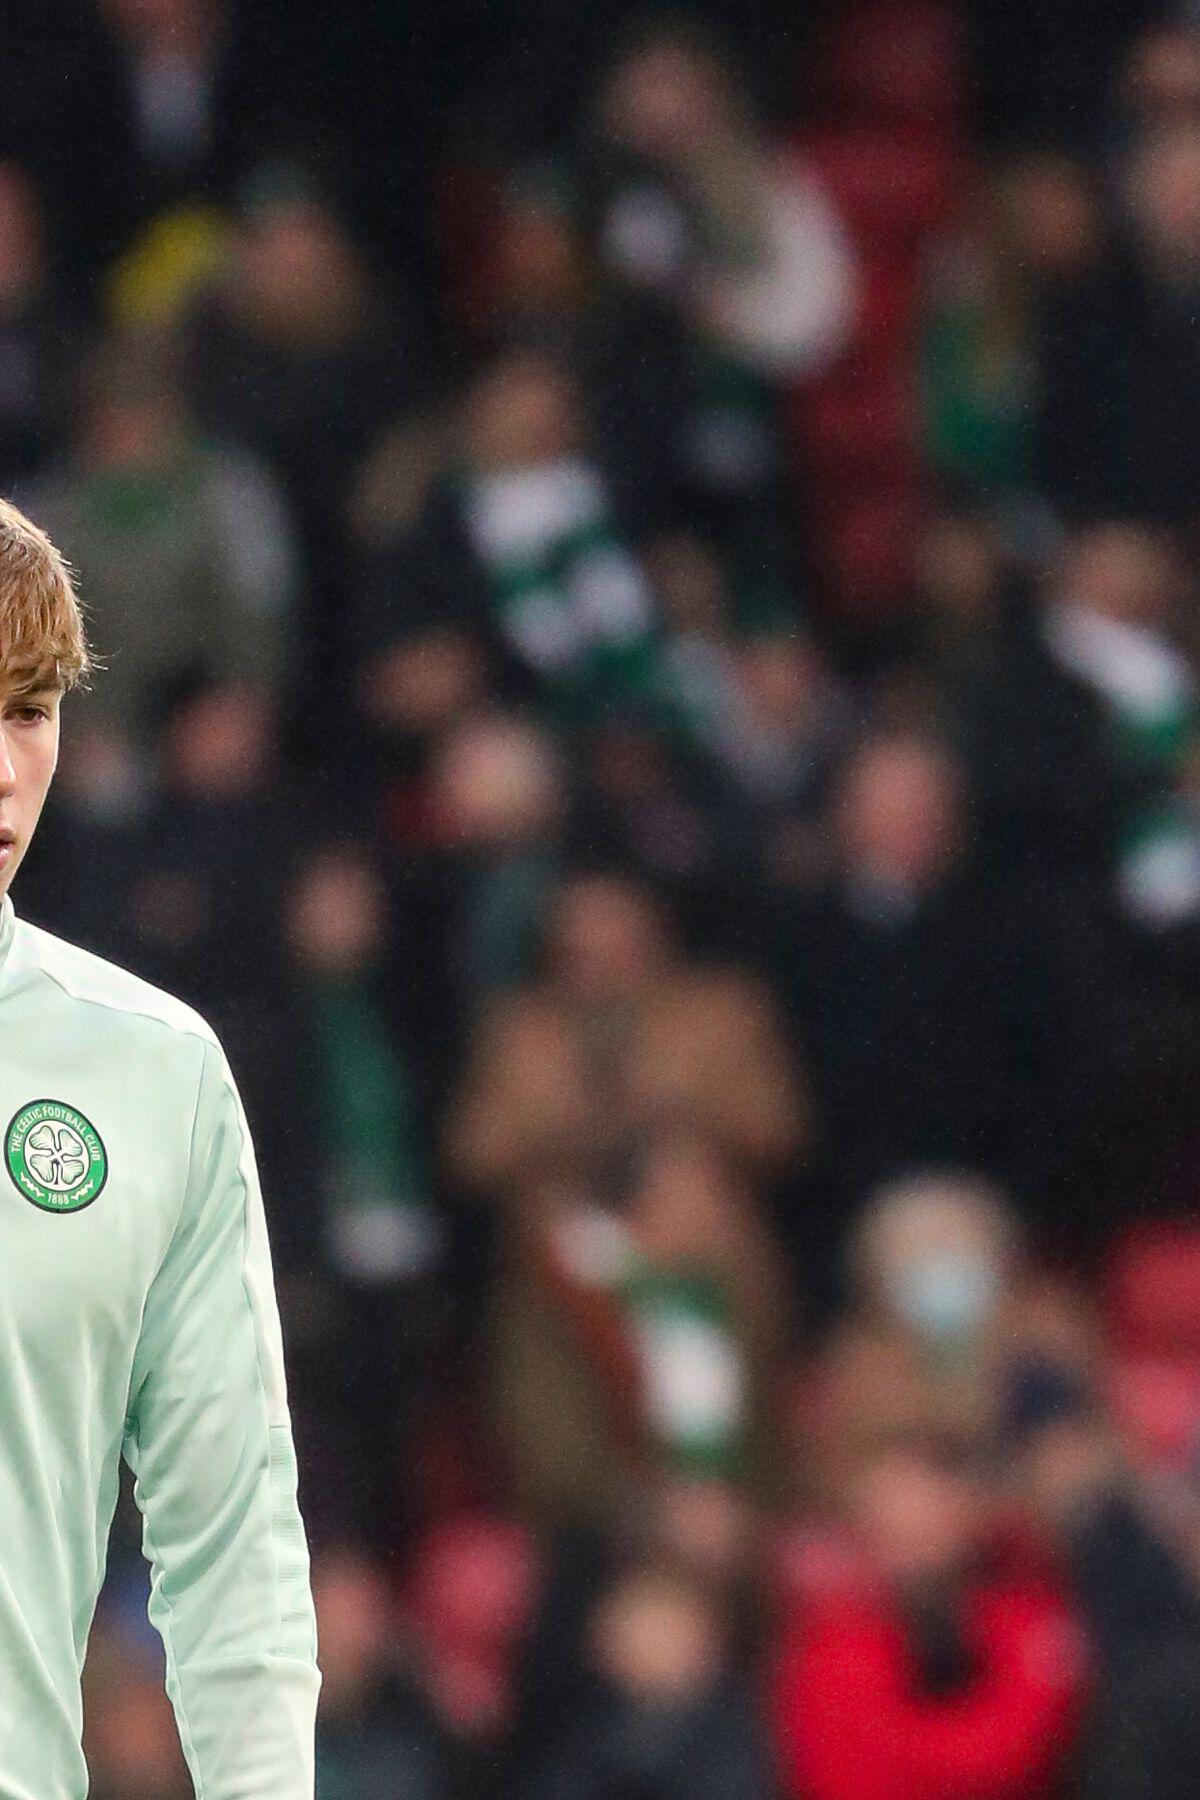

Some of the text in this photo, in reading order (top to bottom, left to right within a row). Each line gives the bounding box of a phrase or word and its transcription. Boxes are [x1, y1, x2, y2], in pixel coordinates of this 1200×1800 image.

[10, 1105, 101, 1162] THE CELTIC FOOTBALL CLUB
